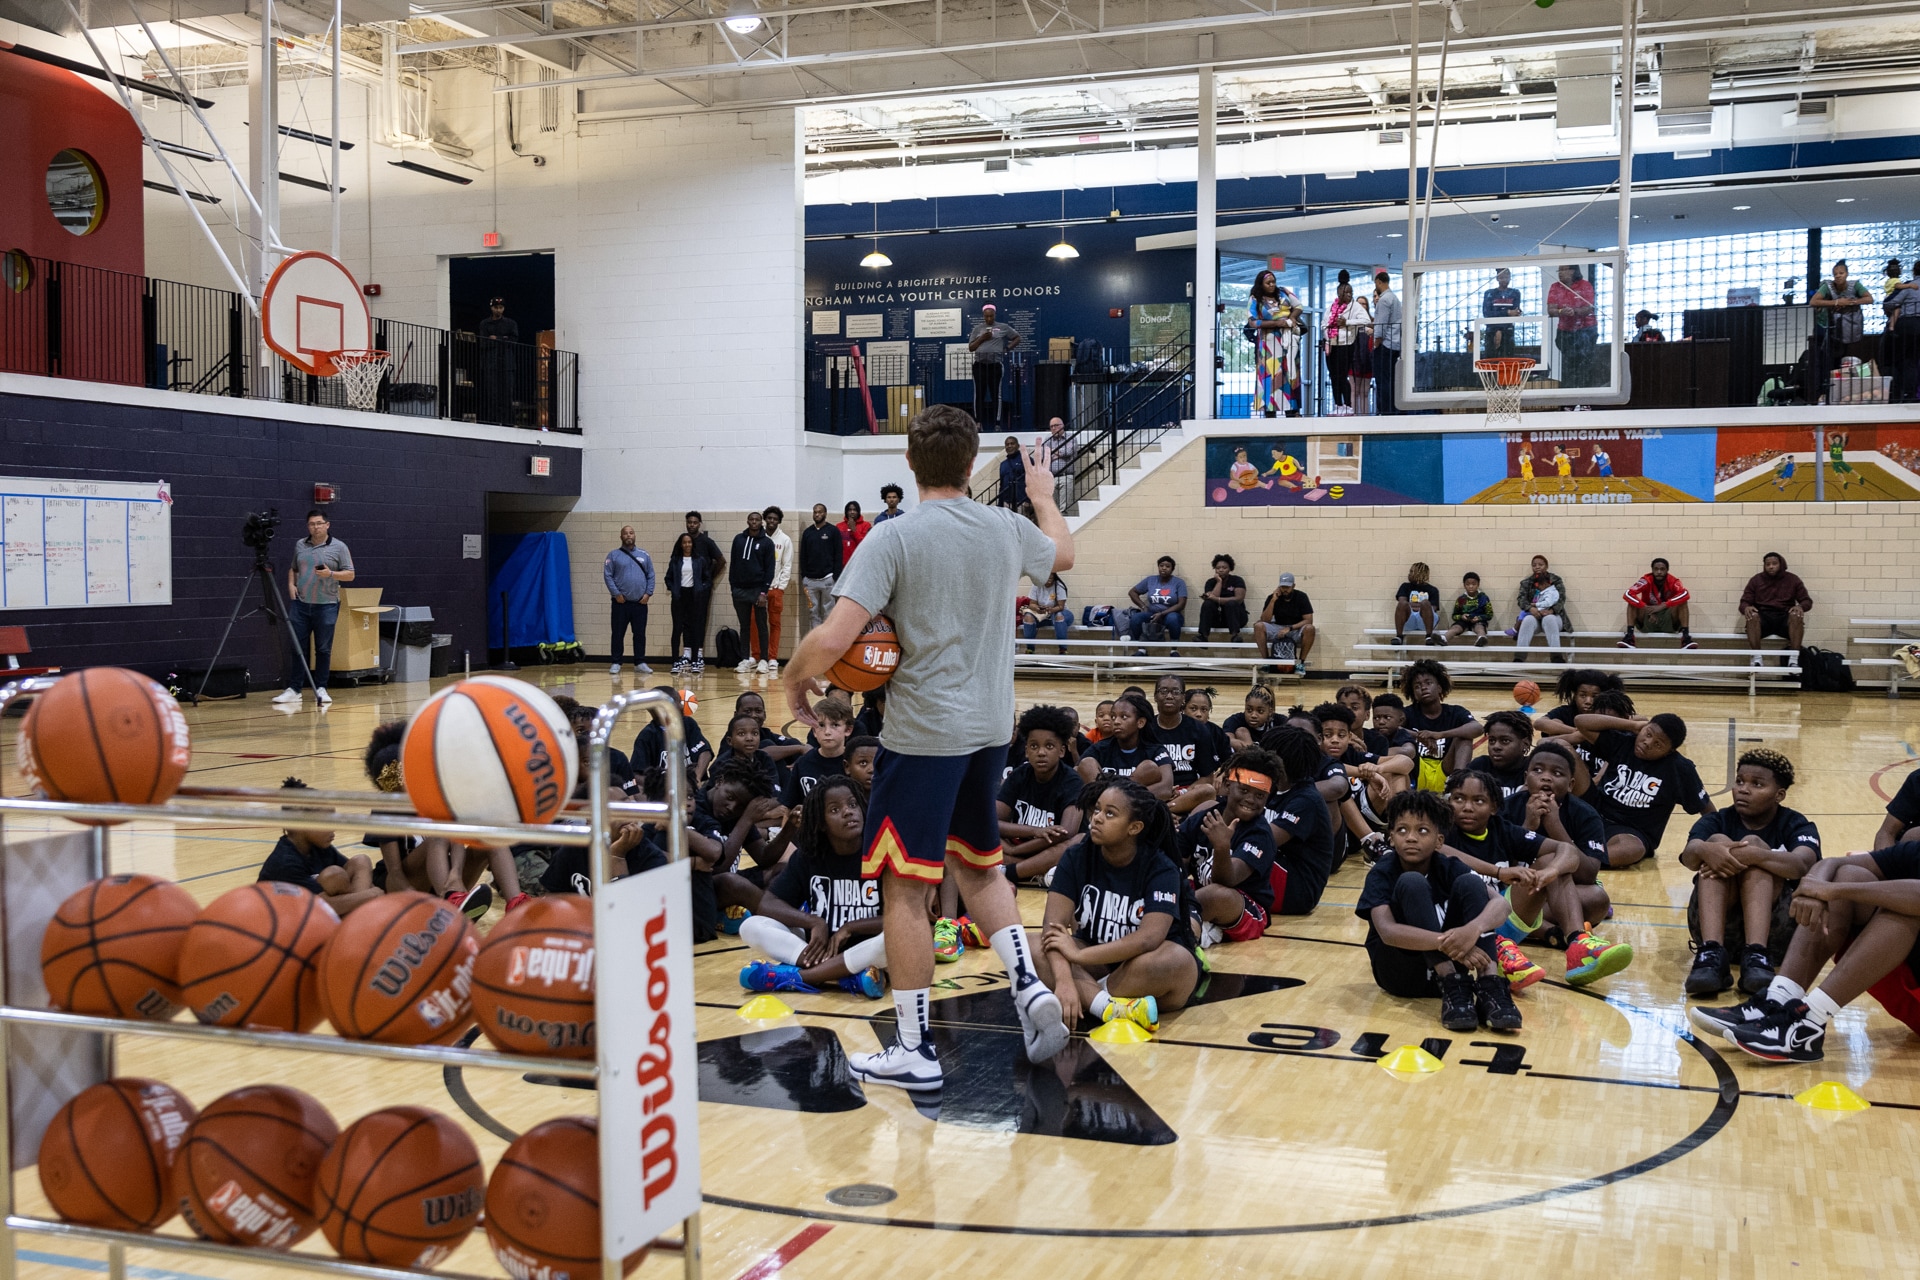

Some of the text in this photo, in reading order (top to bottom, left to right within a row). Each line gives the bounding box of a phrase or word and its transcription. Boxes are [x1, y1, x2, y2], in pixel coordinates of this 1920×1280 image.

[835, 275, 992, 291] BUILDING A BRIGHTER FUTURE:
[858, 293, 894, 304] YMCA
[900, 290, 942, 302] YOUTH
[948, 288, 997, 300] CENTER
[1003, 285, 1061, 298] DONORS
[1140, 315, 1172, 324] DONORS
[1499, 428, 1663, 443] THE BIRMINGHAM YMCA
[1529, 493, 1633, 504] YOUTH CENTER
[1150, 595, 1171, 605] NY
[1153, 588, 1161, 596] I
[503, 703, 558, 818] Wilson
[1612, 787, 1654, 808] LEAGUE
[1025, 804, 1047, 828] NBA
[833, 879, 861, 906] NBA
[1100, 890, 1129, 924] NBA
[370, 907, 456, 998] Wilson
[637, 896, 678, 1214] Wilson
